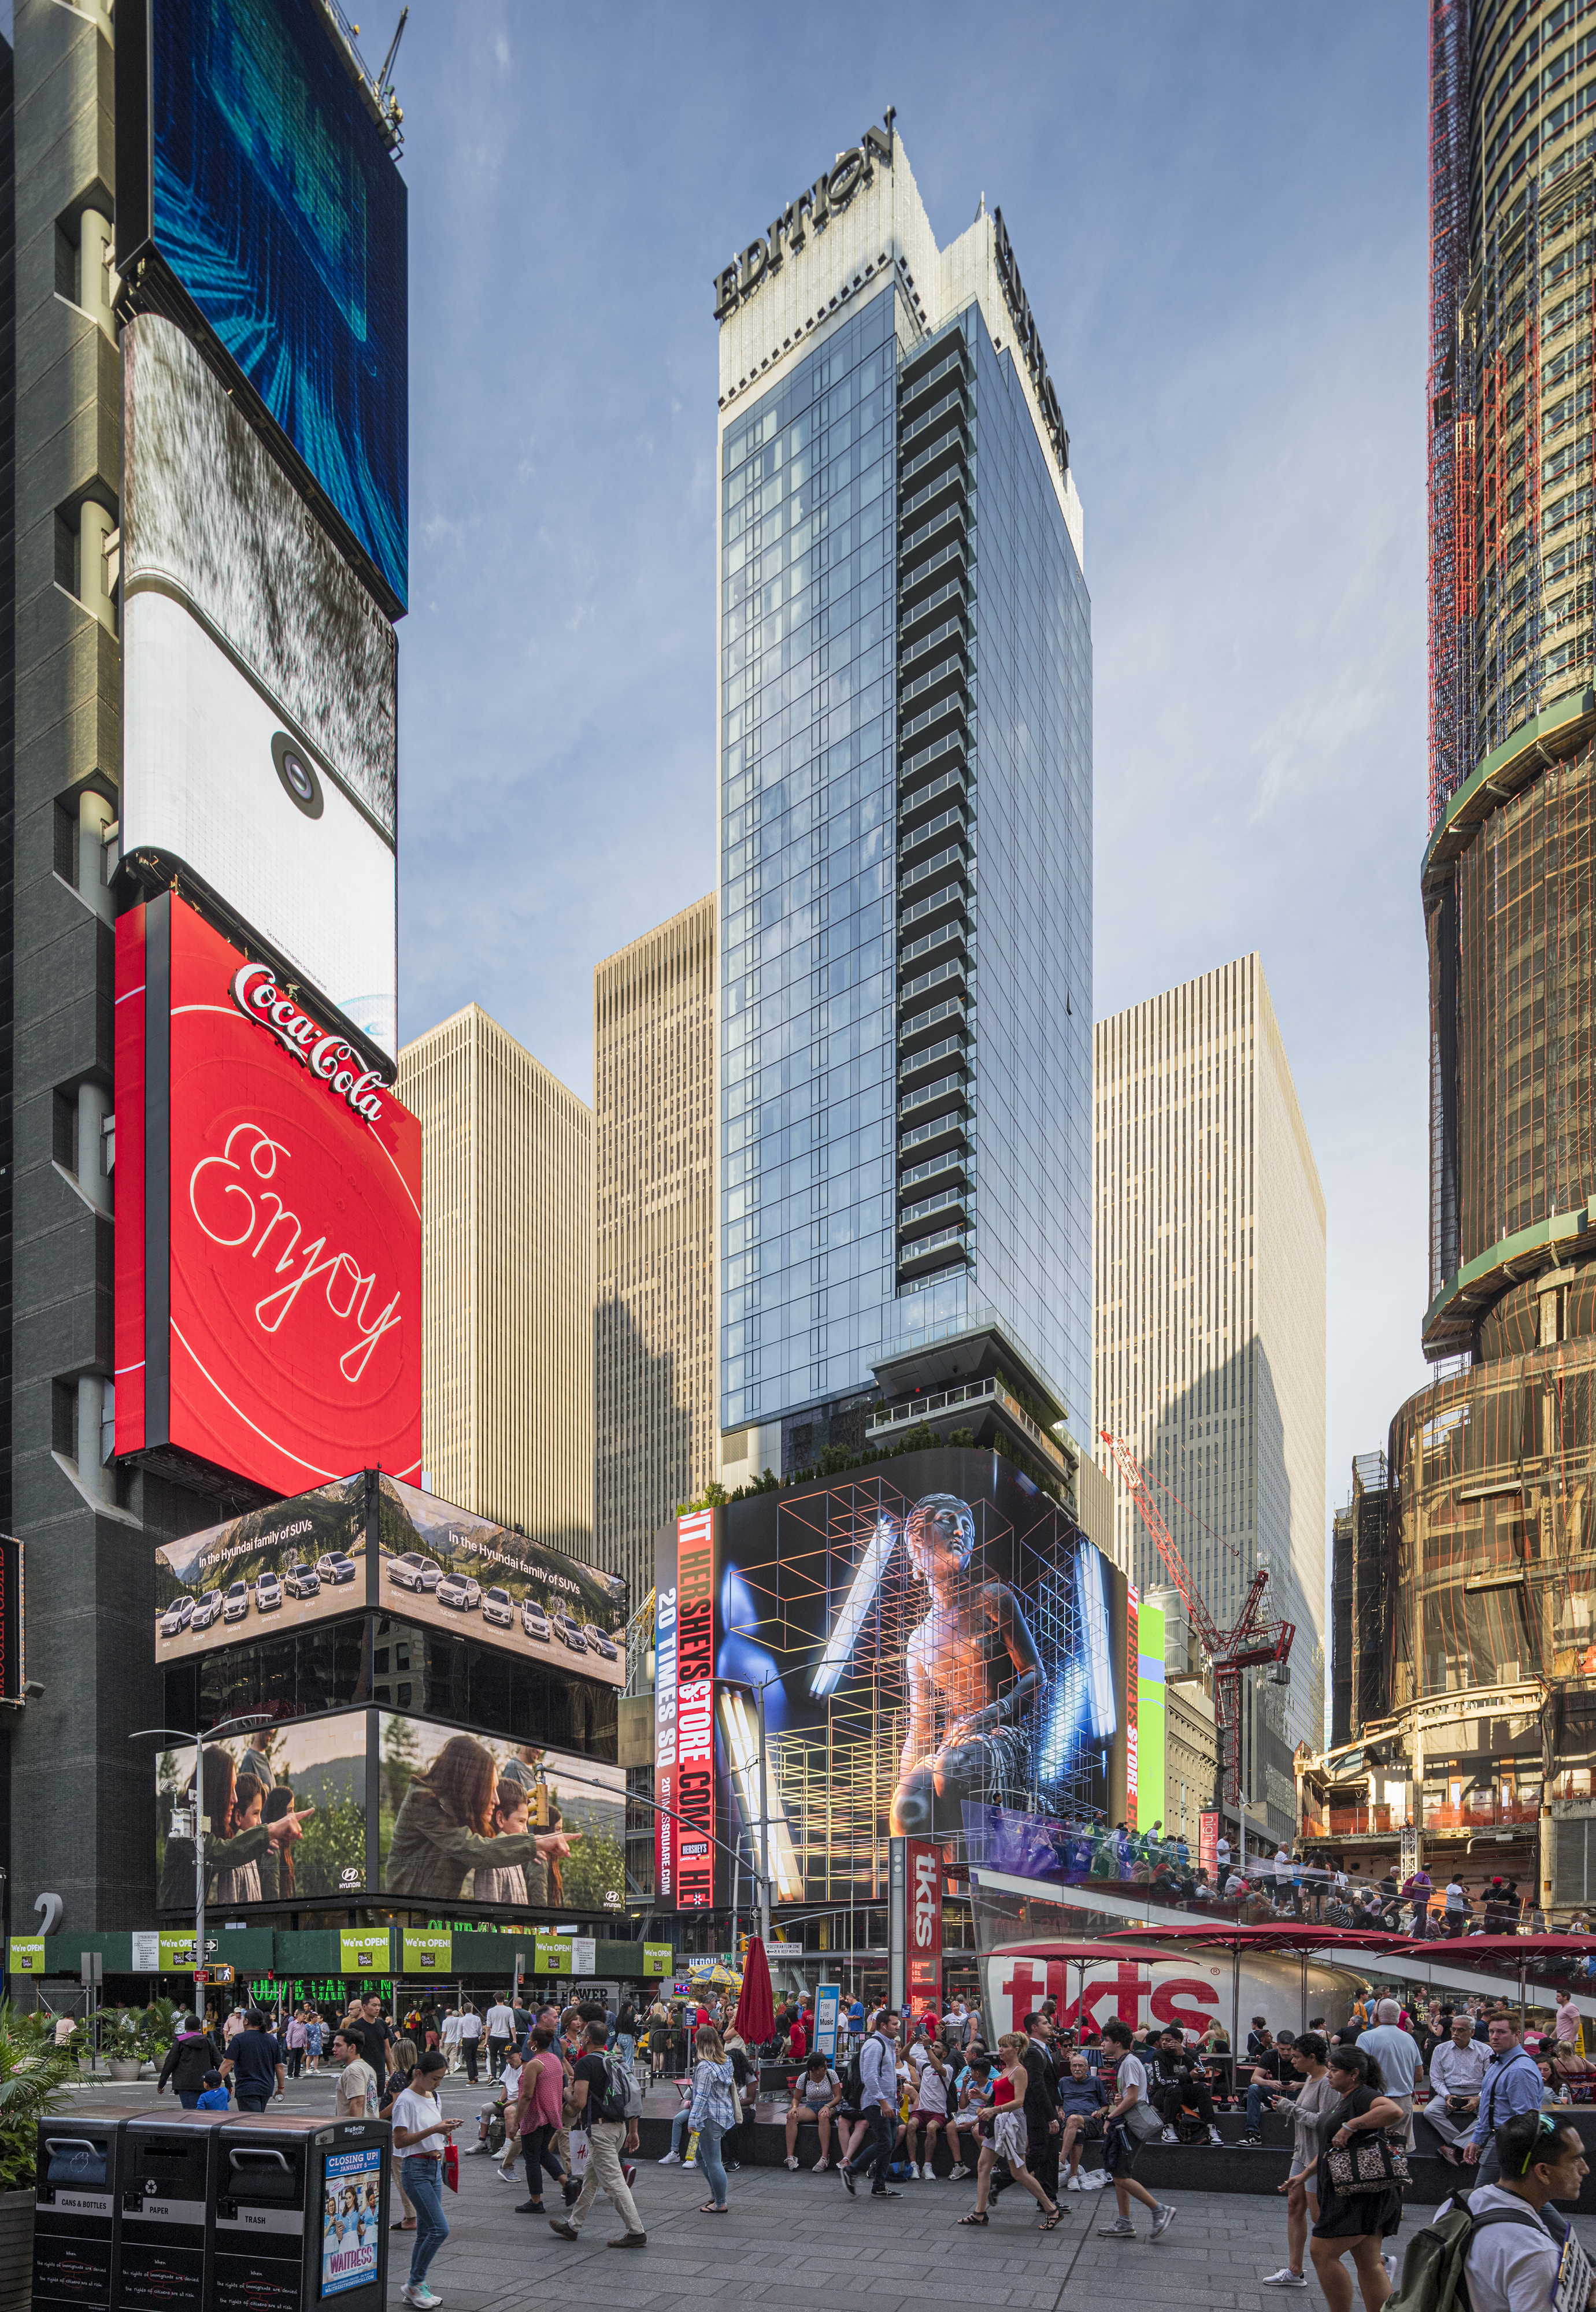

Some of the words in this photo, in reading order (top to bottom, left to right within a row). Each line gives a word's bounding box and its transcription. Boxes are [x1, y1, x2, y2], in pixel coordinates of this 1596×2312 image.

[713, 106, 897, 321] EDITION
[266, 929, 284, 949] Screen
[284, 946, 302, 968] images
[190, 1123, 402, 1382] Enjoy
[199, 1557, 207, 1568] In
[208, 1553, 220, 1566] the
[221, 1539, 253, 1561] Hyundai
[254, 1532, 279, 1547] family
[280, 1526, 290, 1540] of
[290, 1519, 313, 1537] SUVs
[448, 1530, 459, 1544] In
[460, 1535, 477, 1553] the
[479, 1543, 519, 1570] Hyundai
[520, 1559, 547, 1583] family
[548, 1573, 558, 1585] of
[558, 1576, 580, 1595] SUVs
[391, 1589, 404, 1599] NEXO
[439, 1609, 457, 1619] TUCSON
[658, 1588, 676, 1630] 20
[192, 1633, 205, 1642] TUCSON
[487, 1626, 499, 1636] SANTA
[658, 1632, 676, 1723] TIMES
[656, 1727, 676, 1769] SQ
[683, 1843, 707, 1855] HERSHEY'S
[916, 1853, 936, 1947] tkts
[34, 1892, 63, 1936] 2
[160, 1939, 178, 1947] We're
[342, 1938, 363, 1947] We're
[364, 1937, 388, 1947] OPEN!
[405, 1938, 426, 1947] We're
[427, 1939, 450, 1948] OPEN!
[536, 1943, 553, 1951] We're
[561, 1988, 608, 2002] POWER
[1002, 1960, 1220, 2044] tkts
[329, 2154, 364, 2167] CLOSING
[366, 2151, 378, 2161] UP!
[339, 2163, 363, 2172] JANUARY
[61, 2199, 76, 2207] CANS
[83, 2202, 107, 2210] BOTTLES
[149, 2206, 169, 2215] PAPER
[245, 2216, 266, 2224] TRASH
[330, 2246, 372, 2274] WAITRESS
